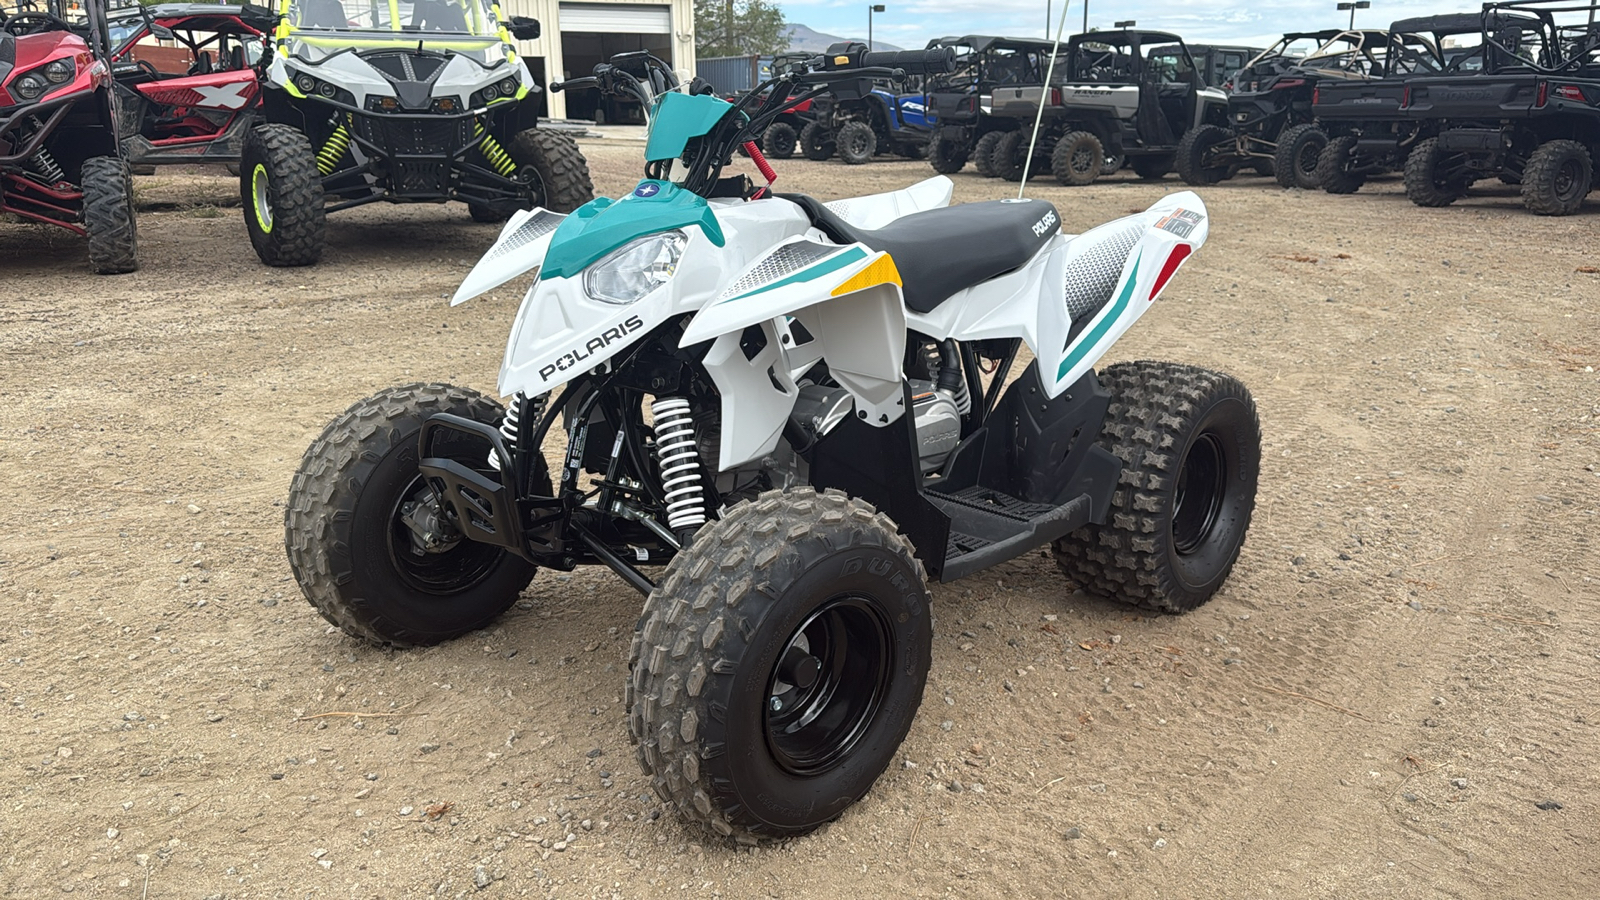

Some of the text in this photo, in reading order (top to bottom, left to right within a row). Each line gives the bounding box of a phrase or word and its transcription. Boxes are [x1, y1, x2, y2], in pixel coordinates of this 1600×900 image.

[1032, 210, 1056, 237] POLARIS
[538, 314, 644, 382] POLARIS
[840, 556, 921, 617] DURO
